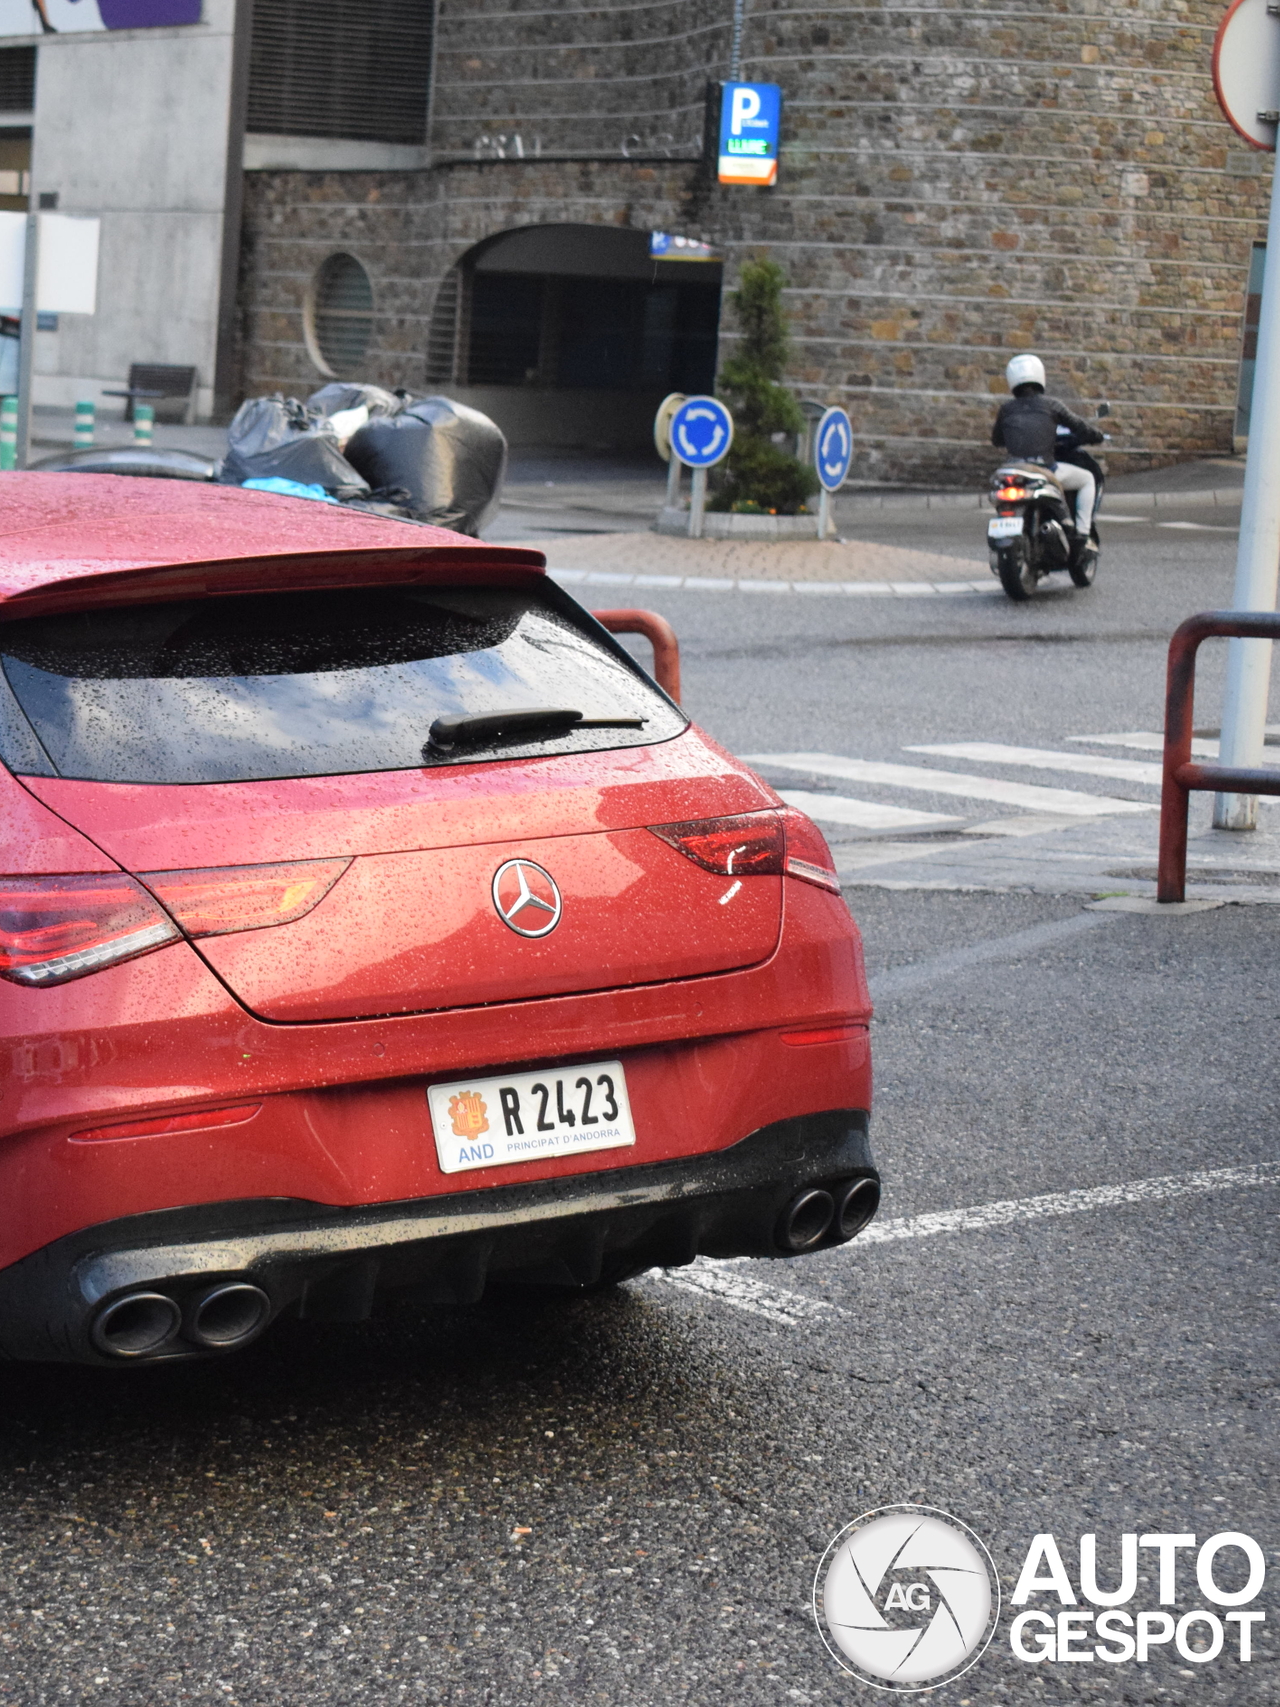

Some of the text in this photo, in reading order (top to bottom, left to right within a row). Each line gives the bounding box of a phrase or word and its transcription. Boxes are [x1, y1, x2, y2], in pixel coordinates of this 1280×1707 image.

[731, 87, 761, 135] P
[499, 1074, 619, 1136] R 2423
[458, 1143, 494, 1163] AND
[507, 1128, 620, 1152] PRINCIPAT D'ANDORRA
